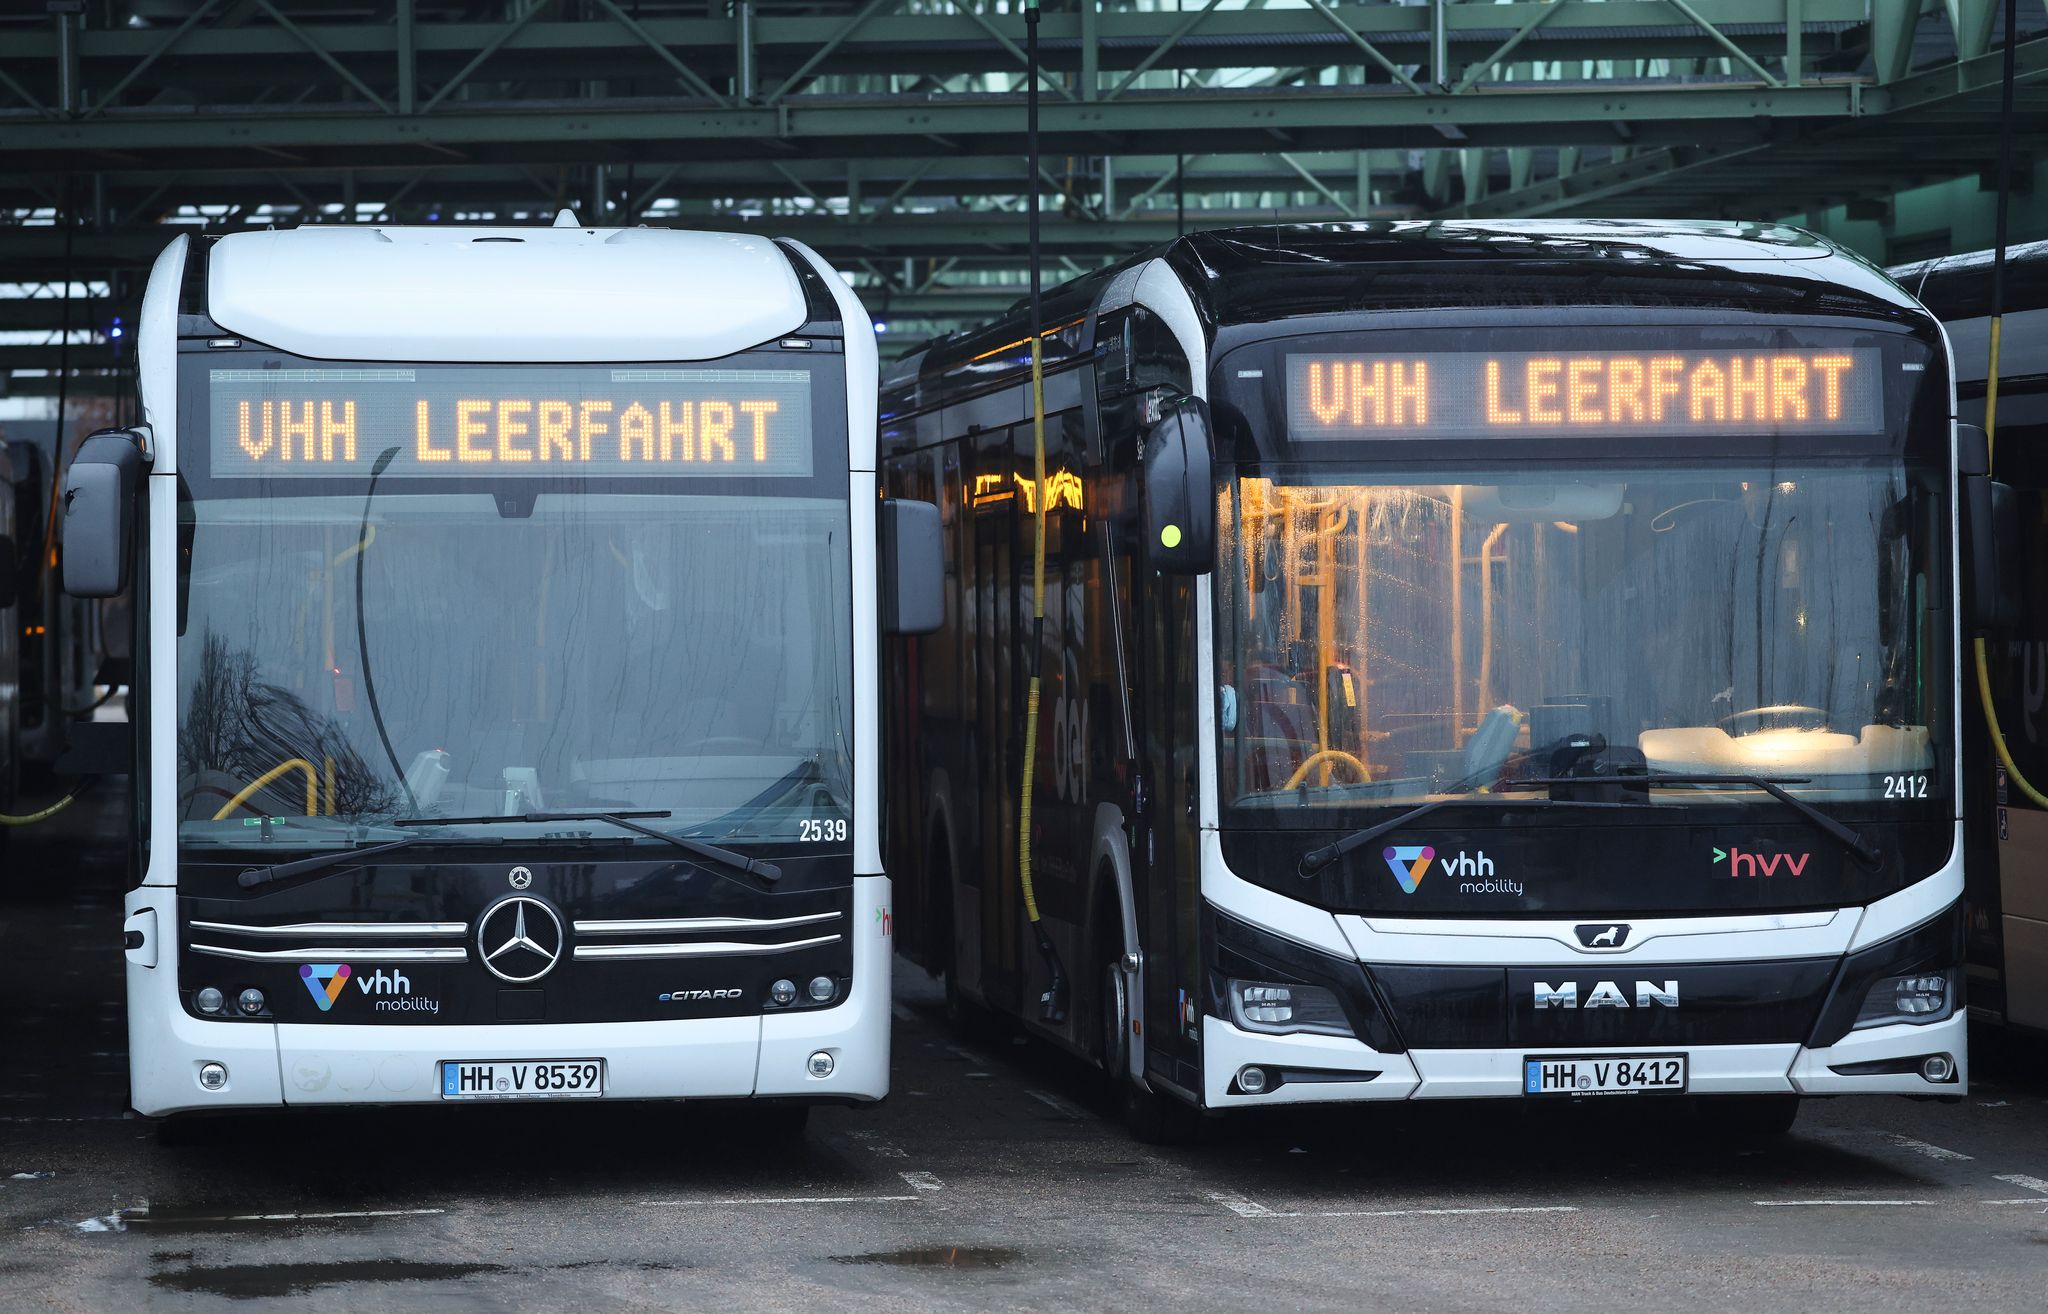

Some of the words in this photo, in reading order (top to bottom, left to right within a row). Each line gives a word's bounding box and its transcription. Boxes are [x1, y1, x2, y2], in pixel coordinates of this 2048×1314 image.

[1309, 362, 1427, 425] VHH
[1486, 355, 1852, 424] LEERFAHRT
[238, 399, 356, 461] VHH
[416, 399, 779, 462] LEERFAHRT
[1883, 775, 1928, 799] 2412
[799, 819, 847, 842] 2539
[1440, 850, 1494, 877] vhh
[1460, 879, 1523, 897] mobility
[356, 968, 410, 995] vhh
[659, 988, 743, 1001] eCITARO
[1534, 980, 1679, 1009] MAN
[375, 997, 439, 1014] mobility
[448, 1082, 455, 1090] D
[460, 1066, 494, 1091] HH
[512, 1065, 528, 1090] V
[534, 1065, 598, 1090] 8539
[1530, 1080, 1537, 1088] D
[1542, 1064, 1576, 1088] HH
[1594, 1063, 1610, 1087] V
[1616, 1061, 1680, 1086] 8412
